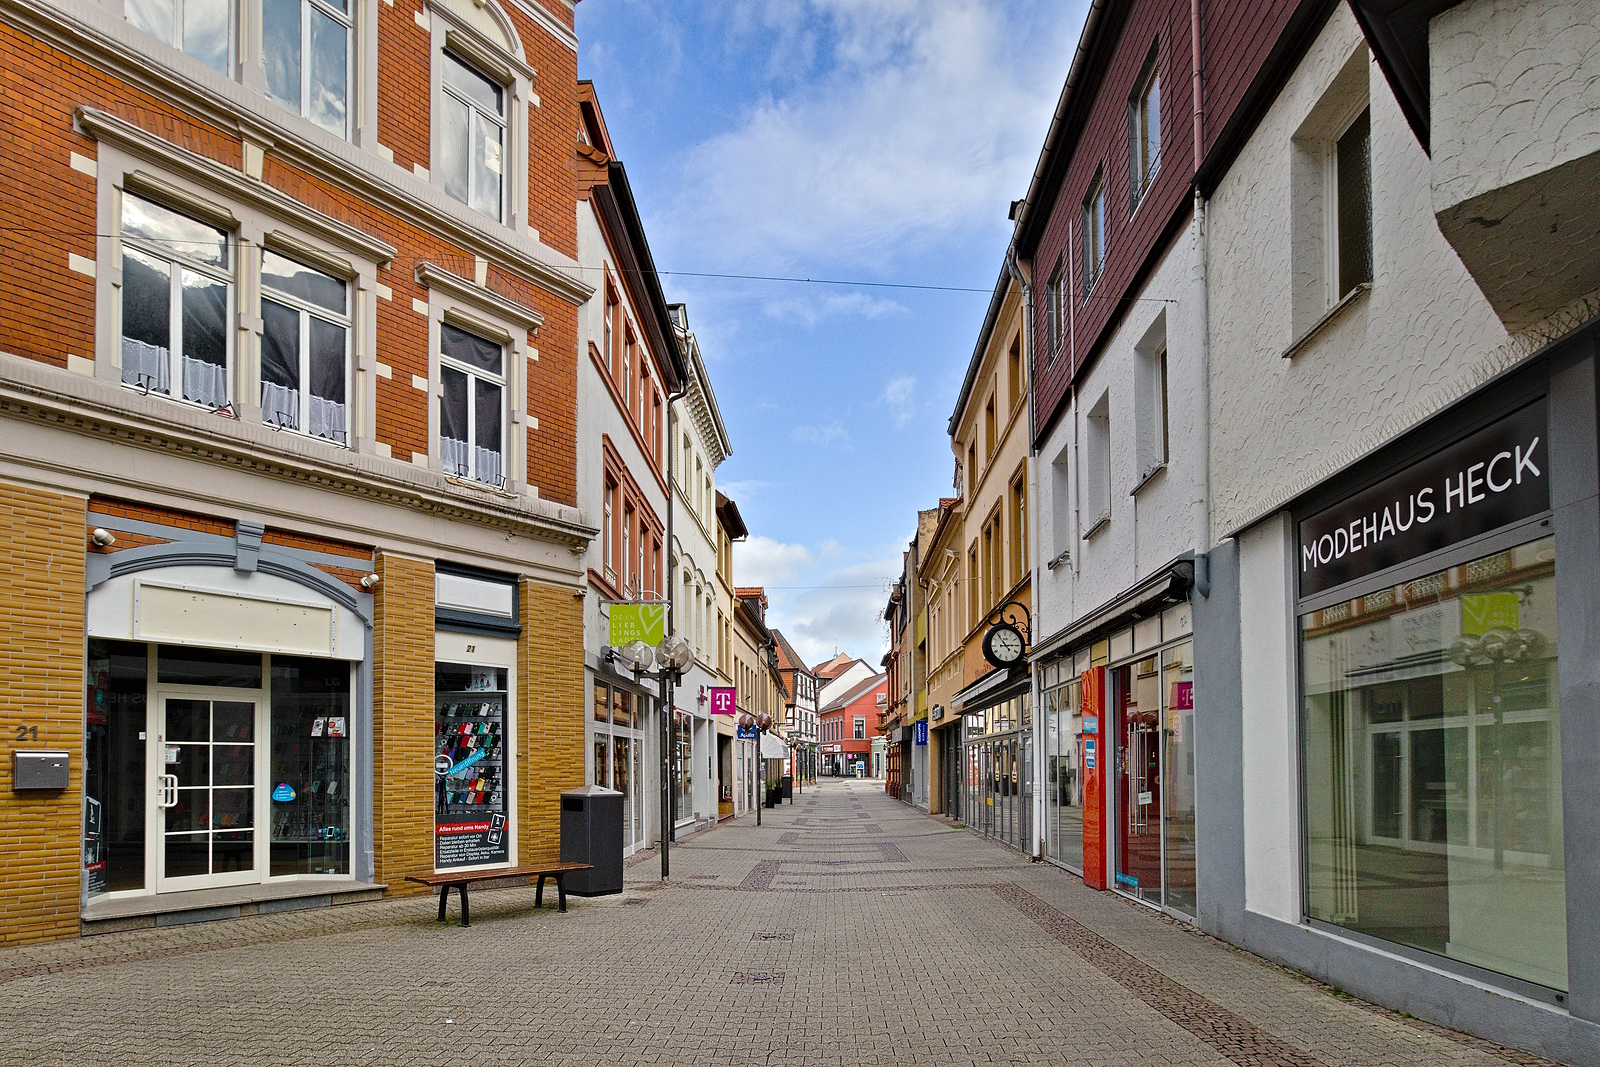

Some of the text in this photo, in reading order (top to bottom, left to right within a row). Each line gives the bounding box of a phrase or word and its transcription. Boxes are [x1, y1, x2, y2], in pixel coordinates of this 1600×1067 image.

[1303, 437, 1541, 572] MODEHAUS HECK
[466, 645, 476, 653] 21
[324, 677, 341, 687] LG
[716, 693, 731, 711] T
[16, 725, 38, 741] 21
[450, 751, 485, 776] Neueröffnung
